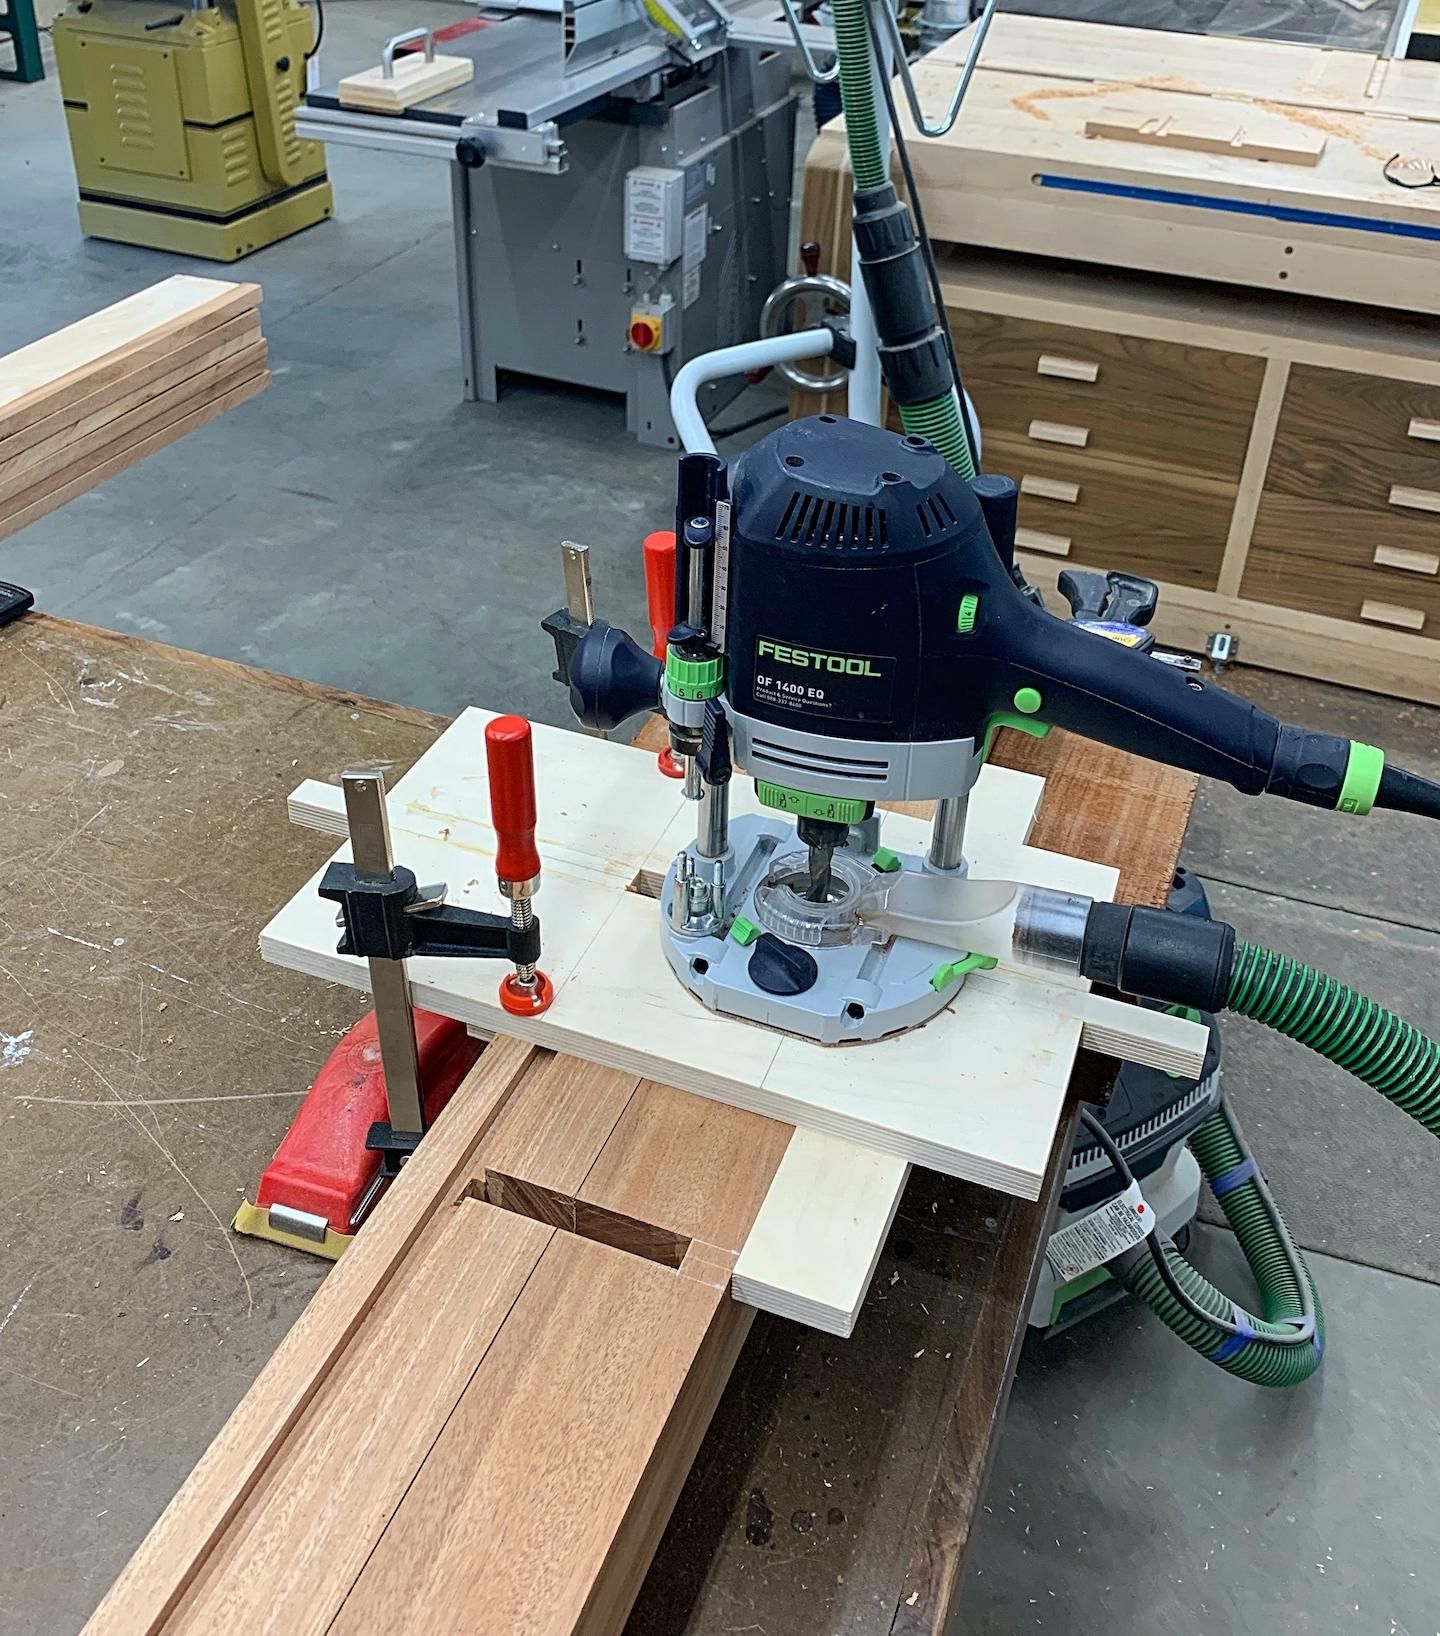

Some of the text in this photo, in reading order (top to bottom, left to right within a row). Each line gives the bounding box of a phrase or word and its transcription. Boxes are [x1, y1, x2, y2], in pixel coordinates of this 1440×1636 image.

[758, 640, 882, 677] FESTOOL
[678, 688, 685, 697] 5
[696, 690, 703, 699] 6
[775, 680, 804, 695] 1400
[807, 687, 825, 699] EQ
